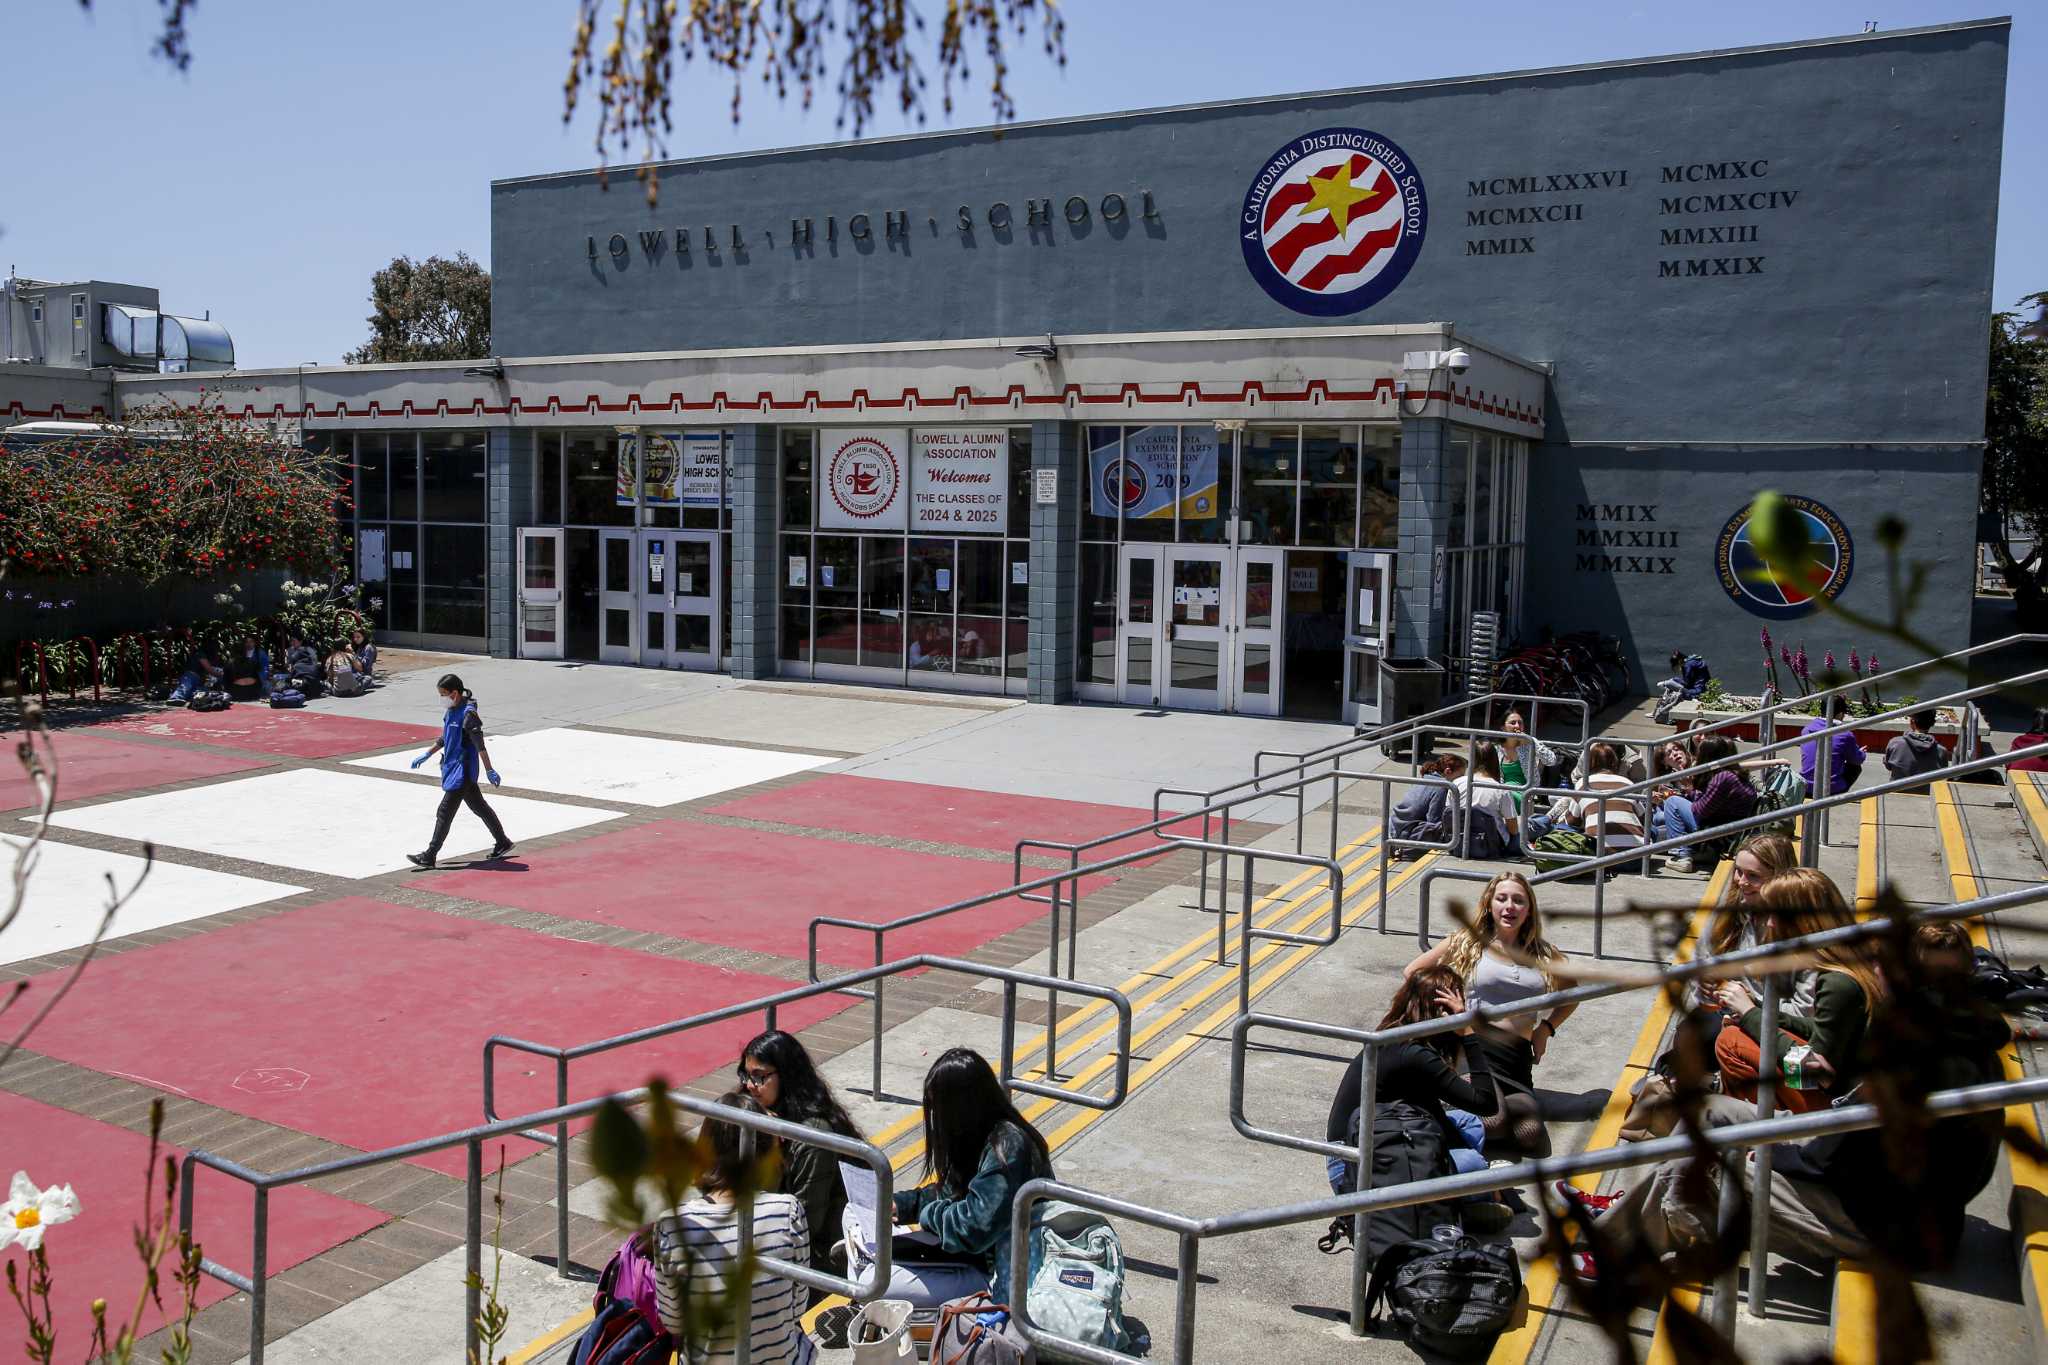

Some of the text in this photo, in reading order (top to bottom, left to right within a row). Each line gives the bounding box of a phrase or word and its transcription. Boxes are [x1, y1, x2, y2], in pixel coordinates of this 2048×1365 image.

[1661, 160, 1768, 183] MCMXC
[1243, 133, 1420, 241] A CALIFORNIA DISTINGUISHED SCHOOL
[1468, 170, 1628, 197] MCMLXXXVI
[1659, 191, 1800, 215] MCMXCIV
[586, 187, 1160, 261] LOWELL HIGH SCHOOL
[1467, 204, 1584, 226] MCMXCII
[1659, 225, 1759, 245] MMXIII
[1466, 237, 1535, 256] MMIX
[1658, 256, 1766, 278] MMXIX
[916, 434, 1004, 444] LOWELL ALUMNI
[846, 446, 868, 458] ALUMNI
[923, 449, 996, 459] ASSOCIATION
[684, 468, 703, 477] HIGH
[928, 468, 991, 483] Welcomes
[1155, 473, 1191, 488] 209
[916, 493, 1002, 504] THE CLASSES OF
[920, 509, 998, 522] 2024 & 2025
[1576, 504, 1657, 522] MMIX
[1809, 502, 1849, 550] EDUCATION
[1576, 528, 1679, 547] MMXIII
[1576, 553, 1676, 574] MMXIX
[1824, 550, 1850, 599] PROGRAM
